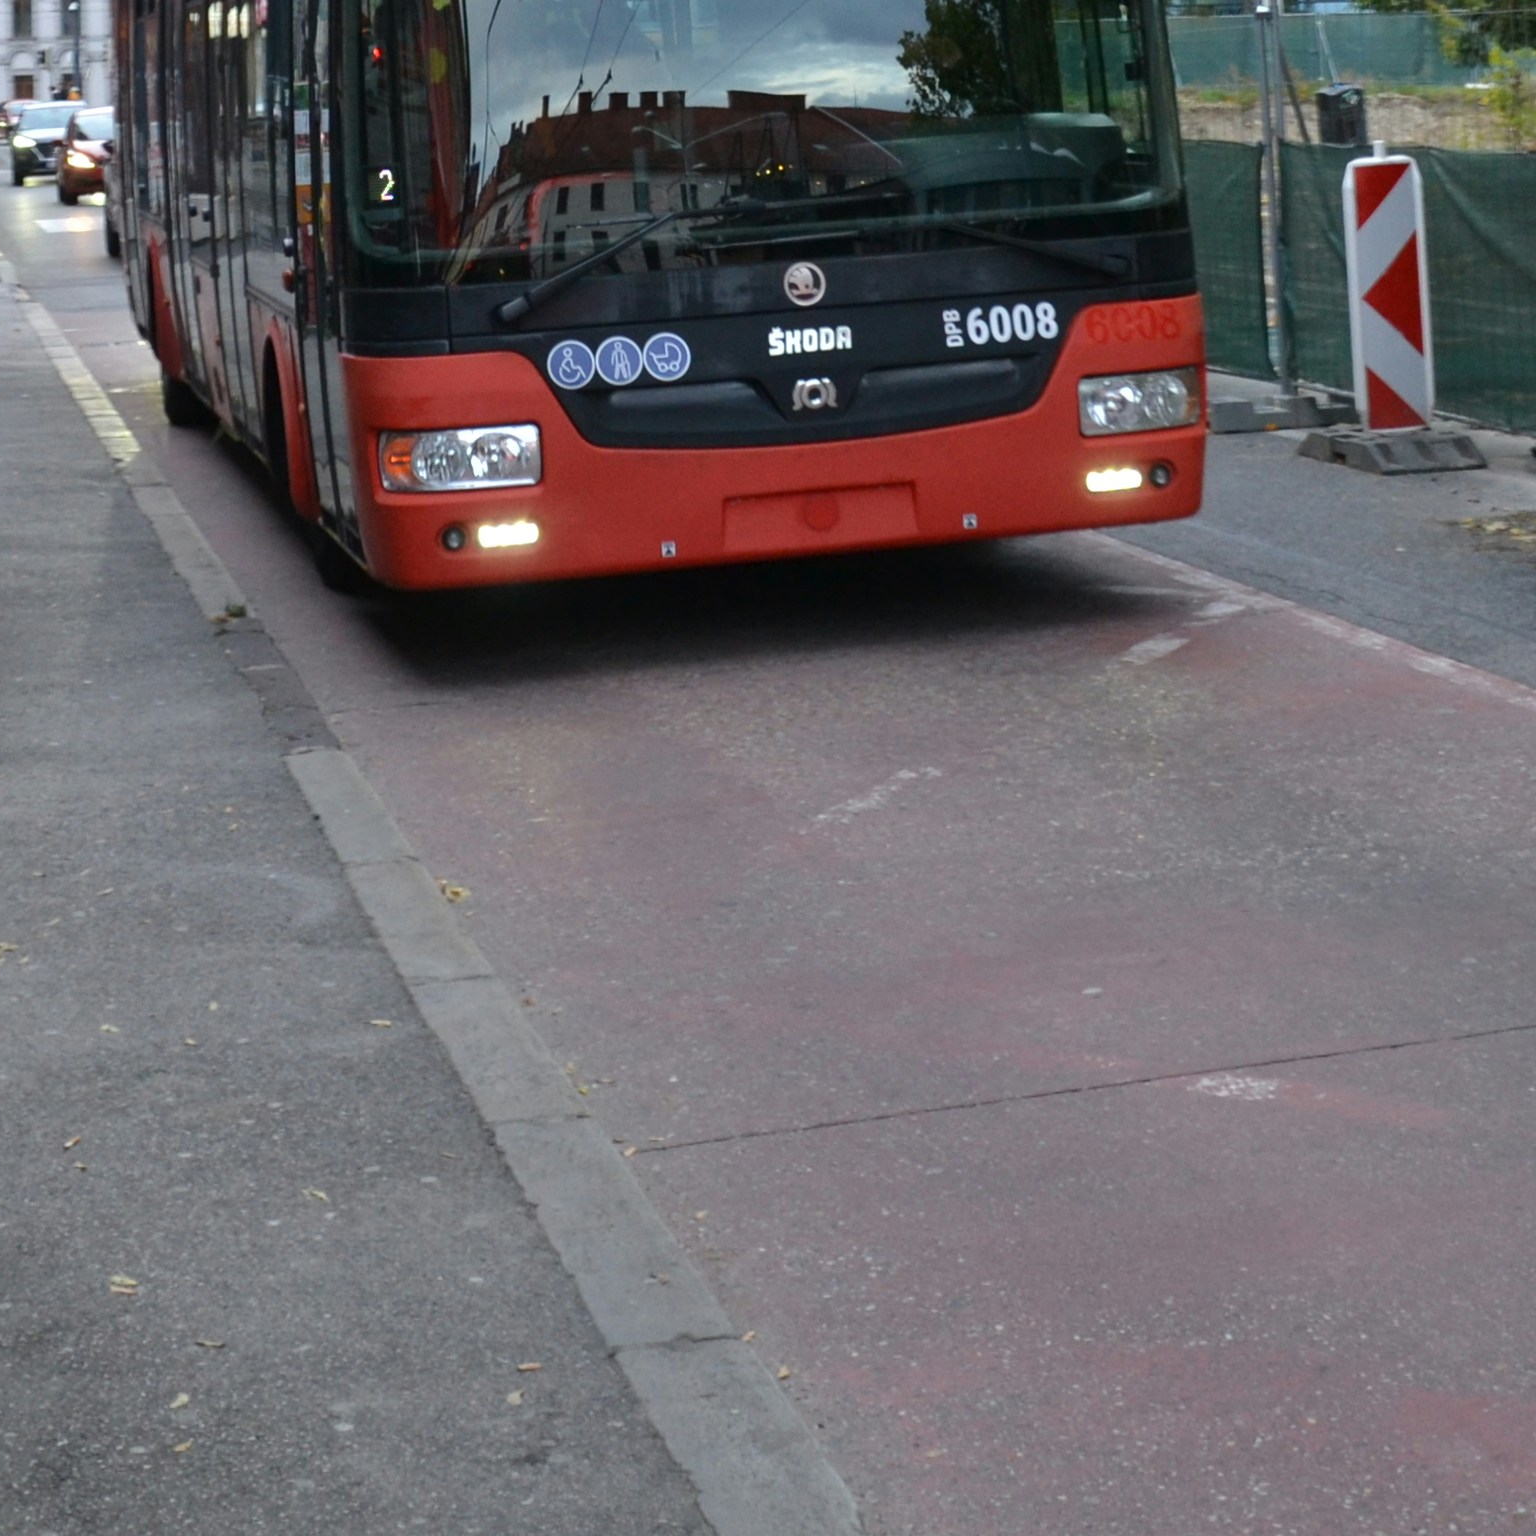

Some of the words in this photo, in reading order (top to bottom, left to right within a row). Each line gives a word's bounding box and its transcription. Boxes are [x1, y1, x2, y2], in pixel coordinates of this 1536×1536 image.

[378, 168, 395, 201] 2
[942, 309, 964, 348] DPB
[966, 301, 1059, 345] 6008
[768, 326, 853, 357] ŠKODA
